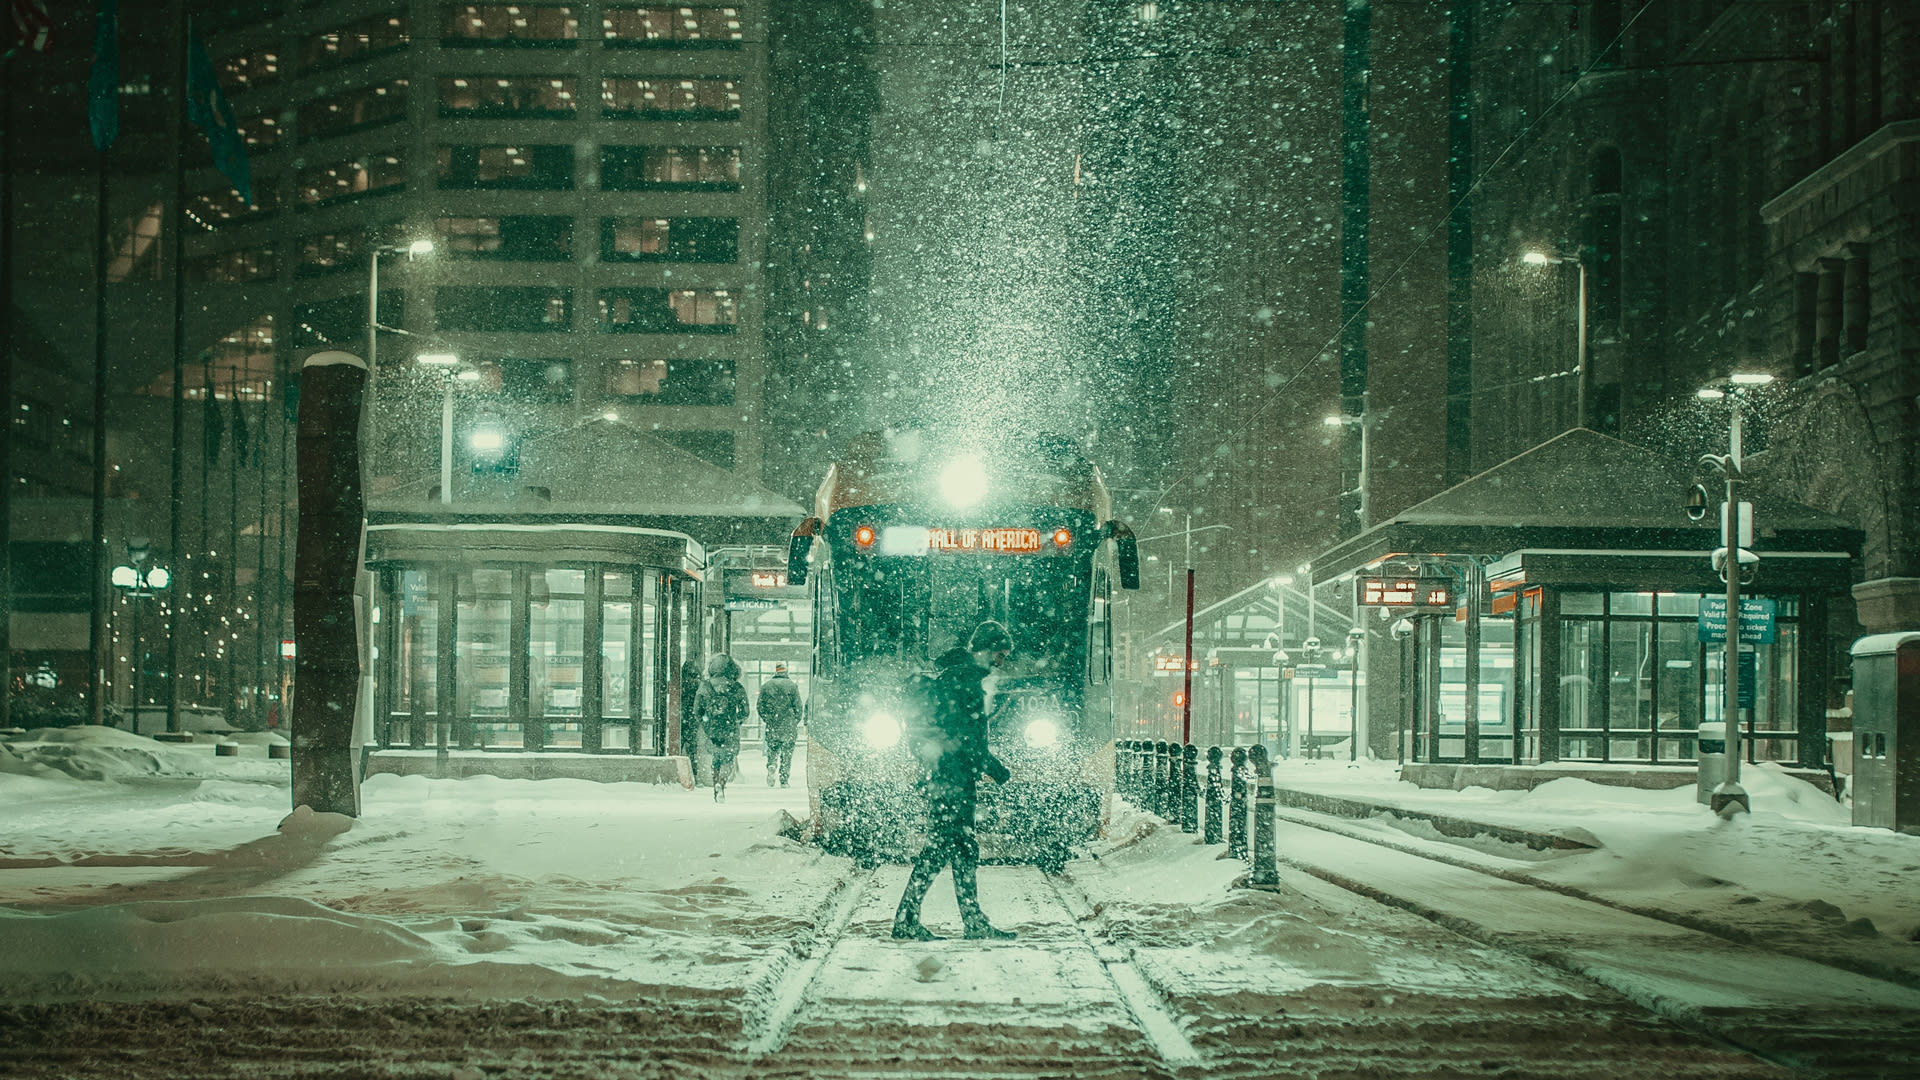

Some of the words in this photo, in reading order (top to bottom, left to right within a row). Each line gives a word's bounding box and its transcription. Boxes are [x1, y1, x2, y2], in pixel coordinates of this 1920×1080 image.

[928, 529, 958, 549] MALL
[962, 529, 977, 549] OF
[981, 529, 1038, 550] AMERICA
[741, 601, 774, 609] TICKETS
[1711, 602, 1726, 610] Paid
[1743, 602, 1763, 611] Zone
[1703, 610, 1720, 618] Valid
[1706, 621, 1727, 630] Proce
[1746, 624, 1767, 632] ticket
